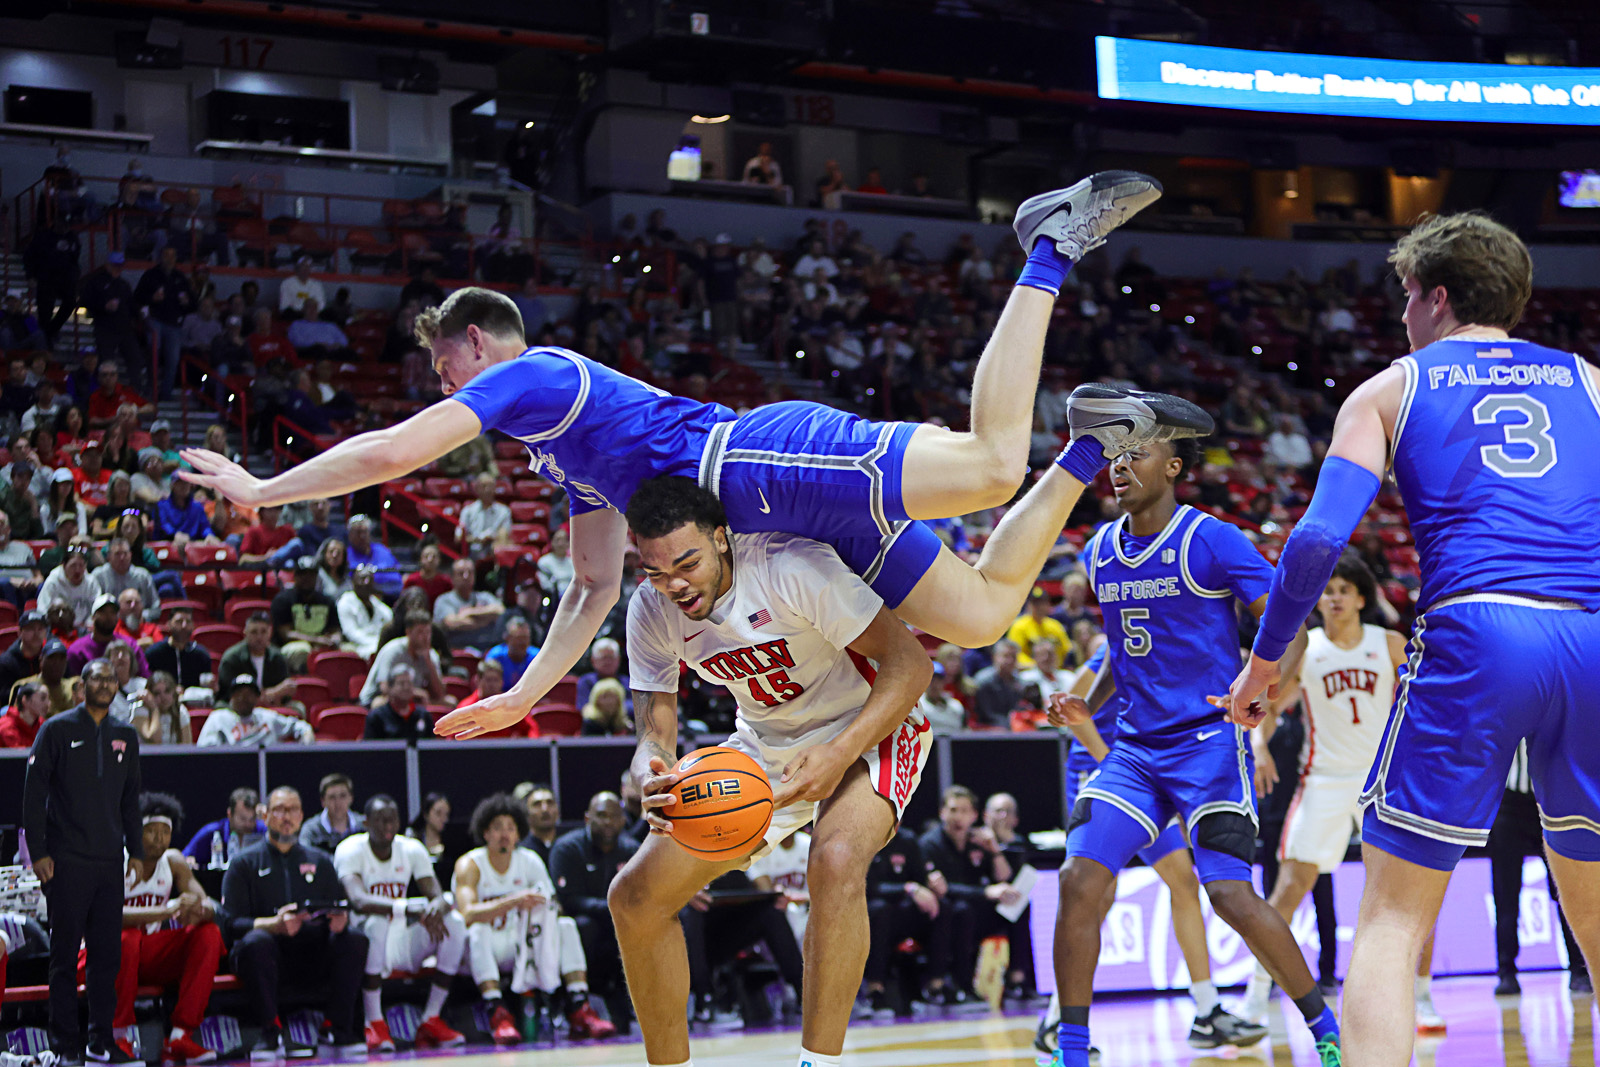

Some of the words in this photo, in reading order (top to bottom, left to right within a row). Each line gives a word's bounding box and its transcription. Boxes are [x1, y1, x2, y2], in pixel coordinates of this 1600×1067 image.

[219, 36, 275, 69] 117
[1324, 74, 1413, 105] Banking
[1413, 79, 1448, 101] for
[1448, 81, 1482, 103] All
[1482, 83, 1531, 104] with
[1532, 84, 1570, 105] the
[794, 95, 835, 125] 118
[1428, 364, 1574, 390] FALCONS
[1472, 393, 1557, 478] 3
[1098, 582, 1120, 603] AIR
[1121, 576, 1181, 600] FORCE
[1120, 608, 1152, 657] 5
[699, 638, 796, 681] UNLV
[747, 669, 804, 707] 45
[1322, 668, 1378, 699] UNLV
[1349, 697, 1361, 724] 1
[681, 778, 741, 804] ELITE
